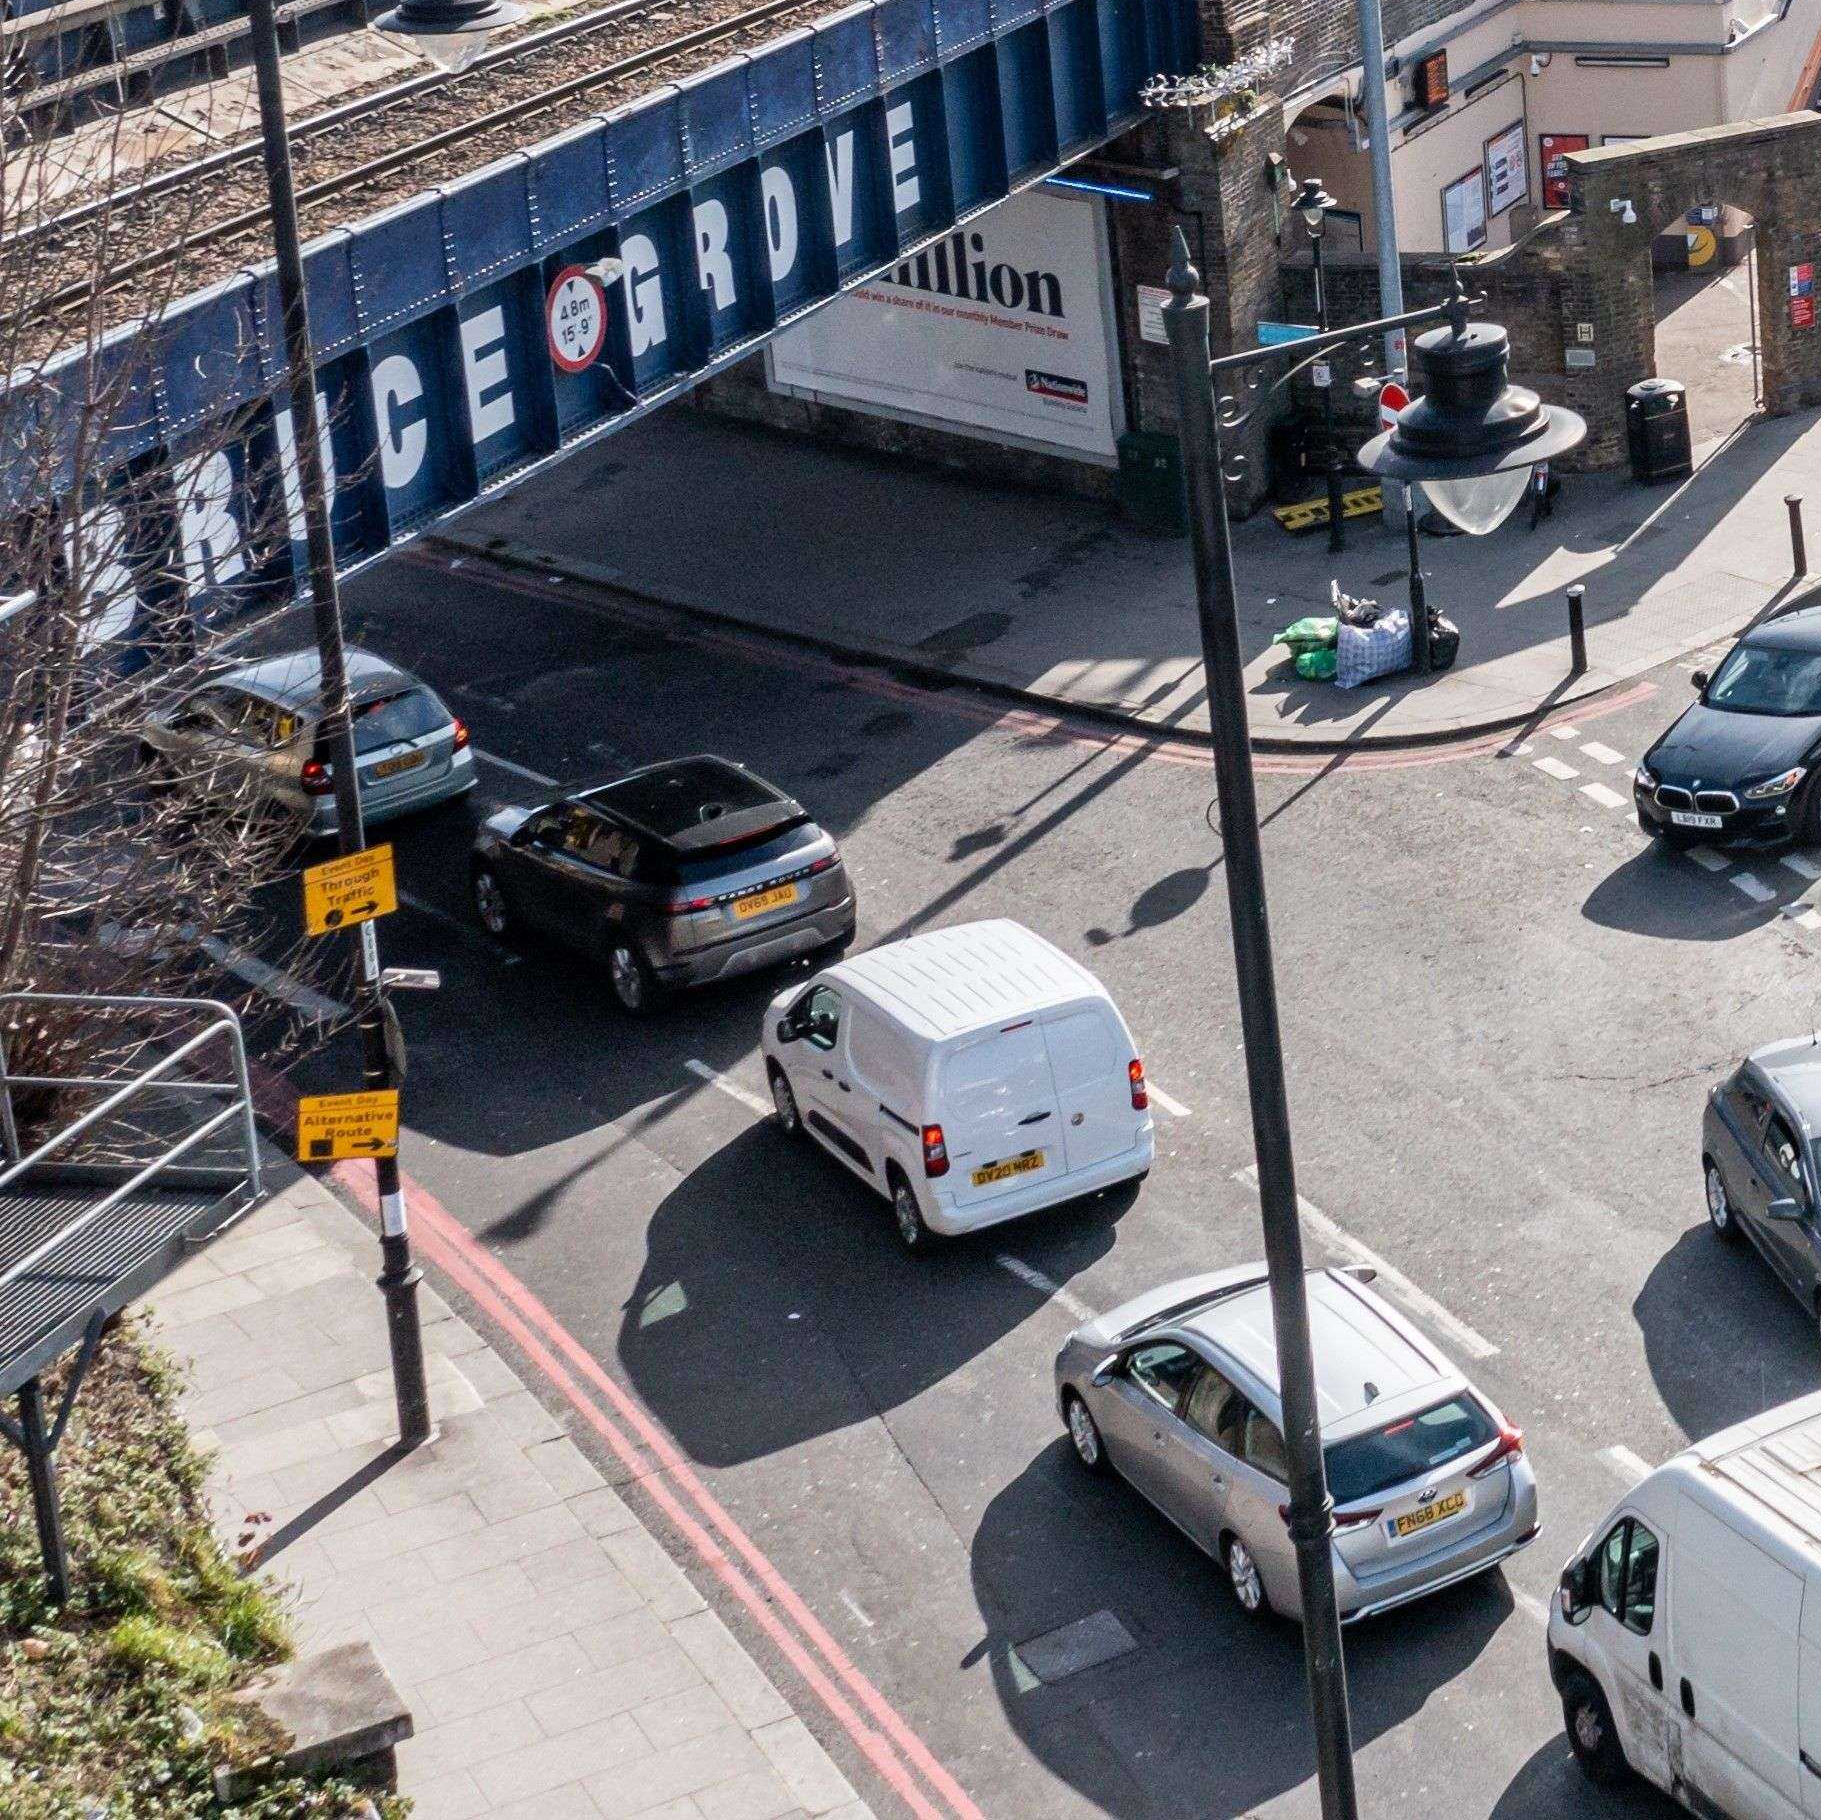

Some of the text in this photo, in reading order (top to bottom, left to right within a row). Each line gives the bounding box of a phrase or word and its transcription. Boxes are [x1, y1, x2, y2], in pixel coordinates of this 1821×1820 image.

[63, 99, 924, 658] BRUCE GROVE
[320, 867, 380, 893] Through
[326, 886, 375, 907] Traffic
[304, 1110, 394, 1127] Alternative
[324, 1126, 373, 1139] Route
